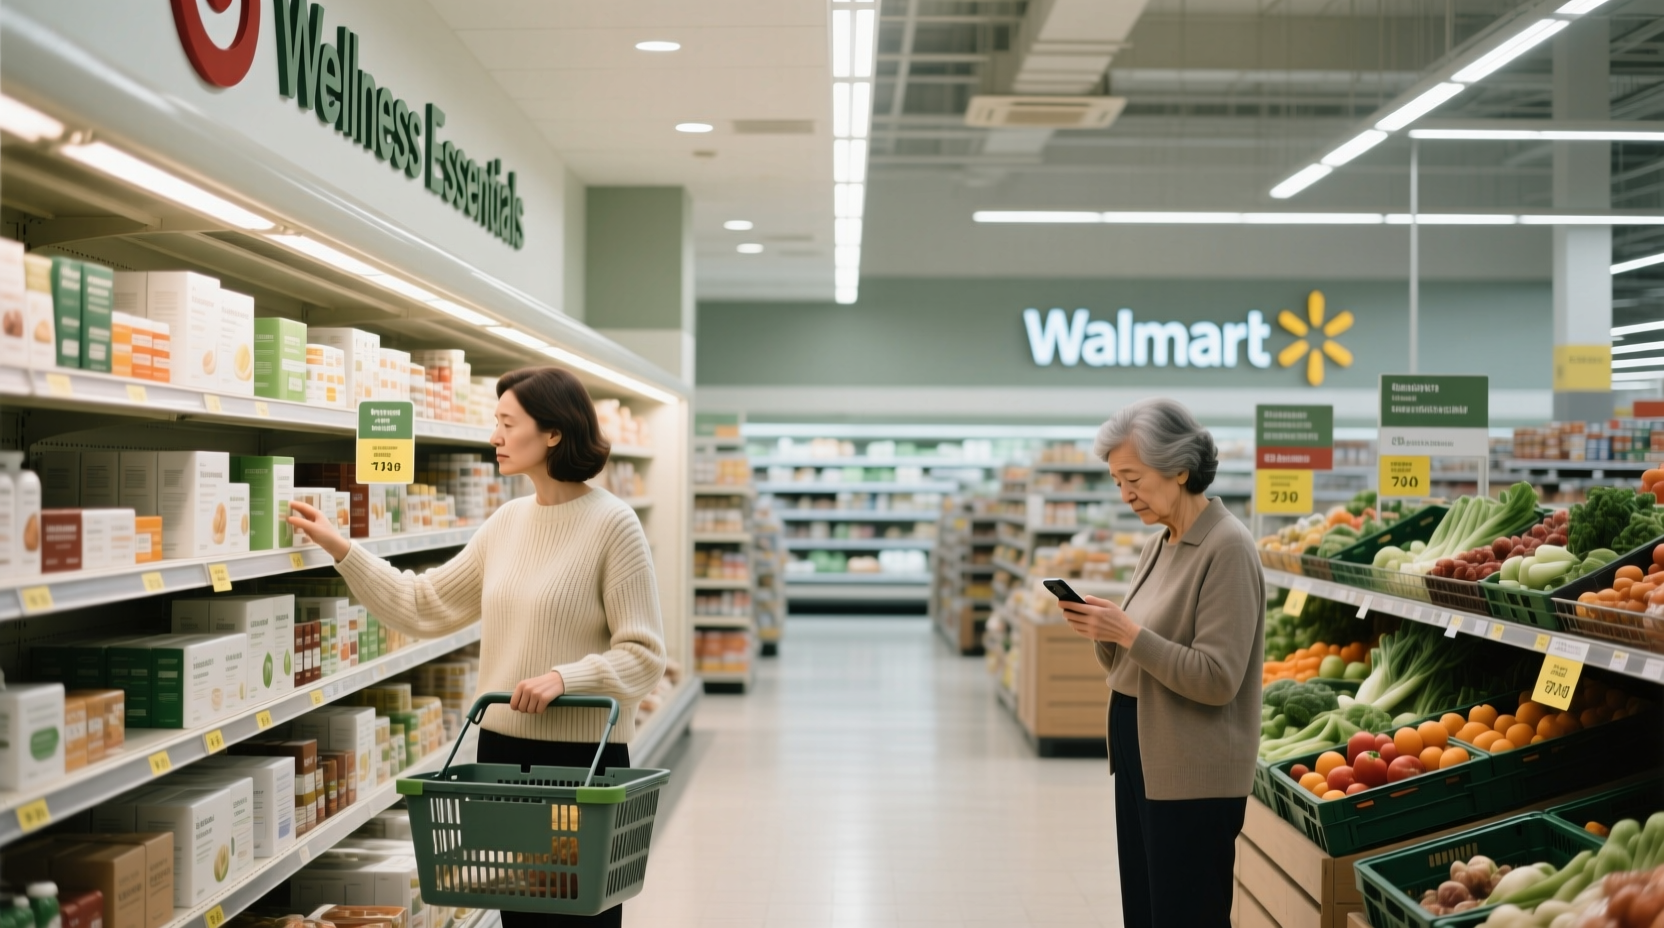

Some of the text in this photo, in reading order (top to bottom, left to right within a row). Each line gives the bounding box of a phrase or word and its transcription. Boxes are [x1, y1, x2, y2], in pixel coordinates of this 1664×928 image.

[274, 0, 524, 250] Wellness Essentials
[1023, 308, 1271, 368] Walmart
